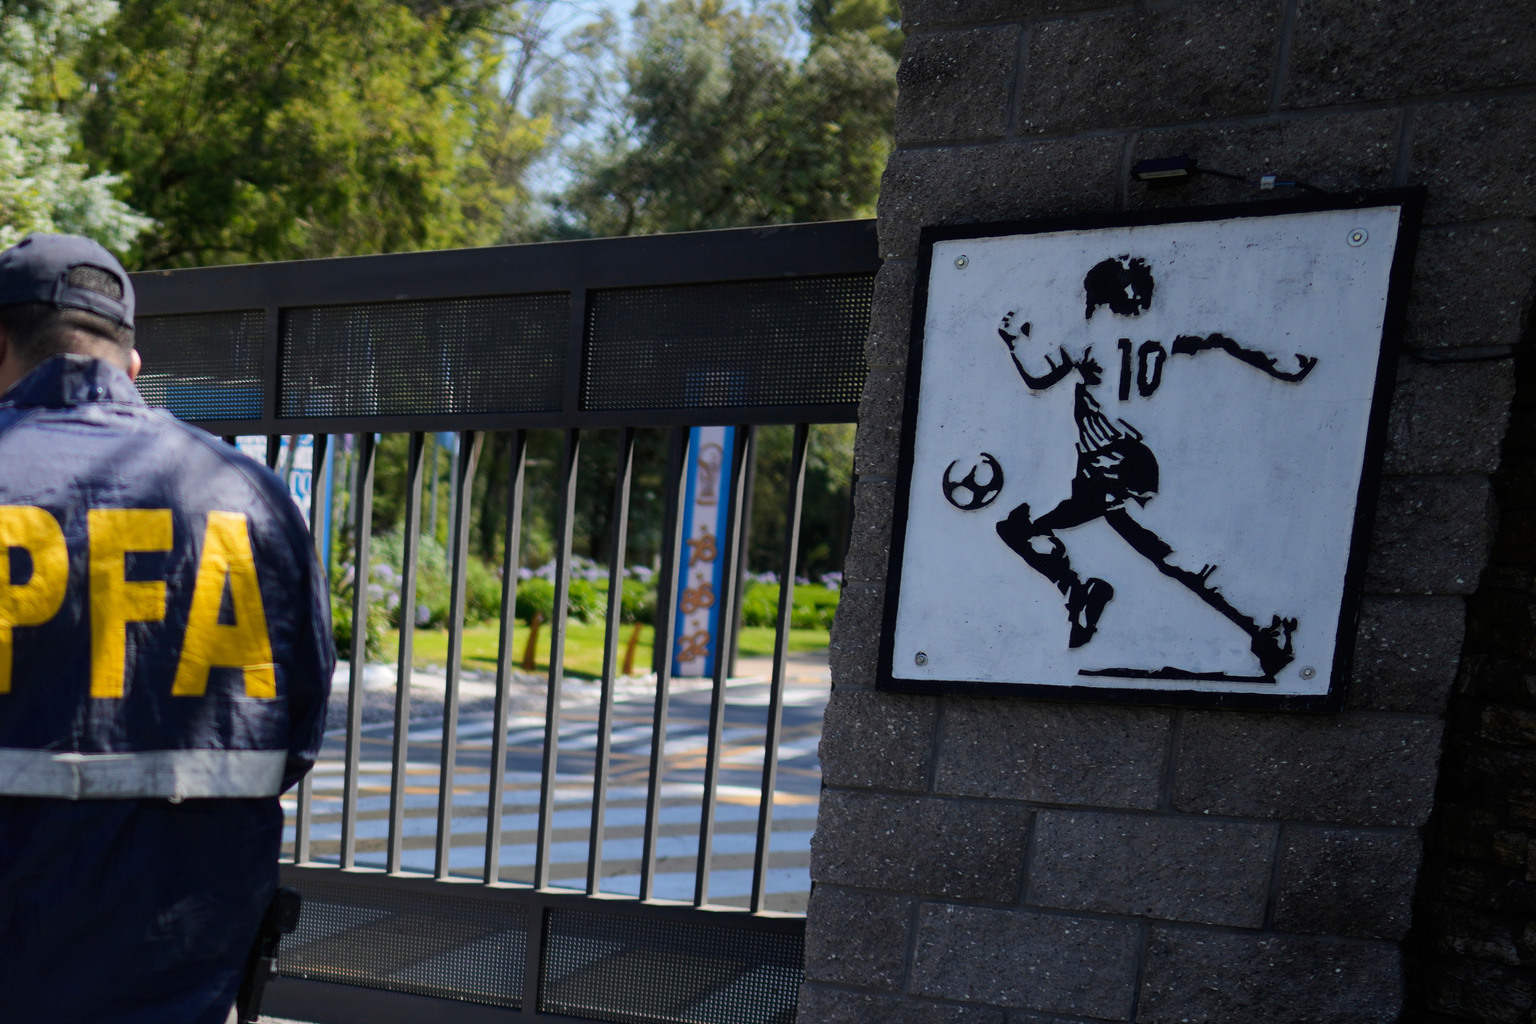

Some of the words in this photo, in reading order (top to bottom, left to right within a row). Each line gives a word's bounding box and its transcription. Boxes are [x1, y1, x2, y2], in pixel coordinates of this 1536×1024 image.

[1117, 338, 1167, 401] 10
[686, 533, 718, 567] 78
[680, 582, 715, 614] 86
